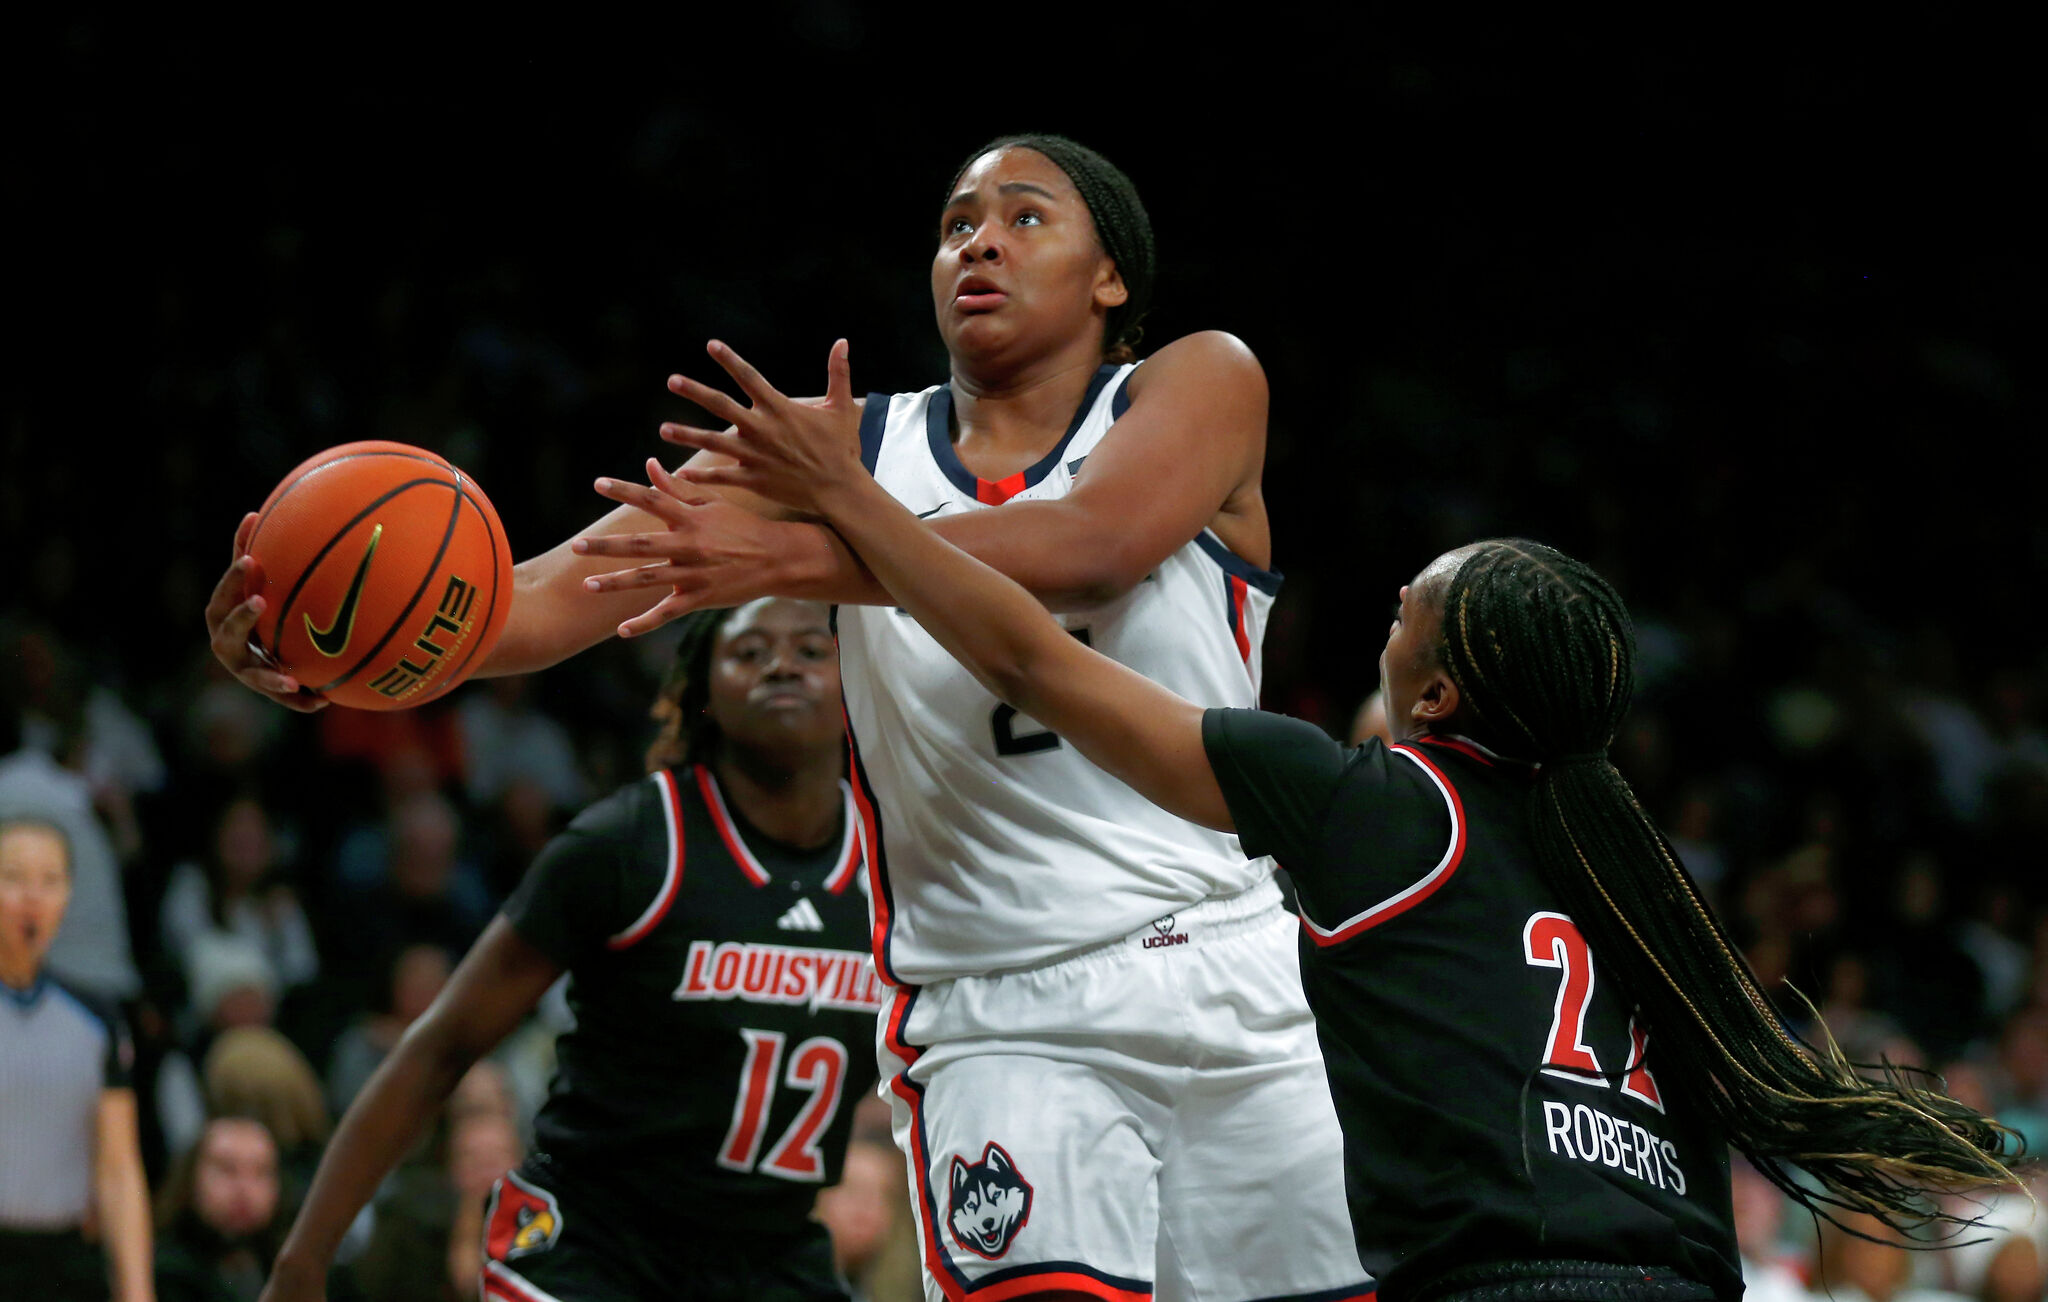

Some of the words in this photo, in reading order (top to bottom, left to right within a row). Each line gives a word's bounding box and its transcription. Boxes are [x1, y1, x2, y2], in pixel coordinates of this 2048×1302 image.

[367, 574, 477, 698] ELITE
[672, 940, 881, 1016] LOUISVILL
[1142, 933, 1189, 949] UCONN
[715, 1027, 849, 1183] 12
[1543, 1100, 1687, 1196] ROBERTS
